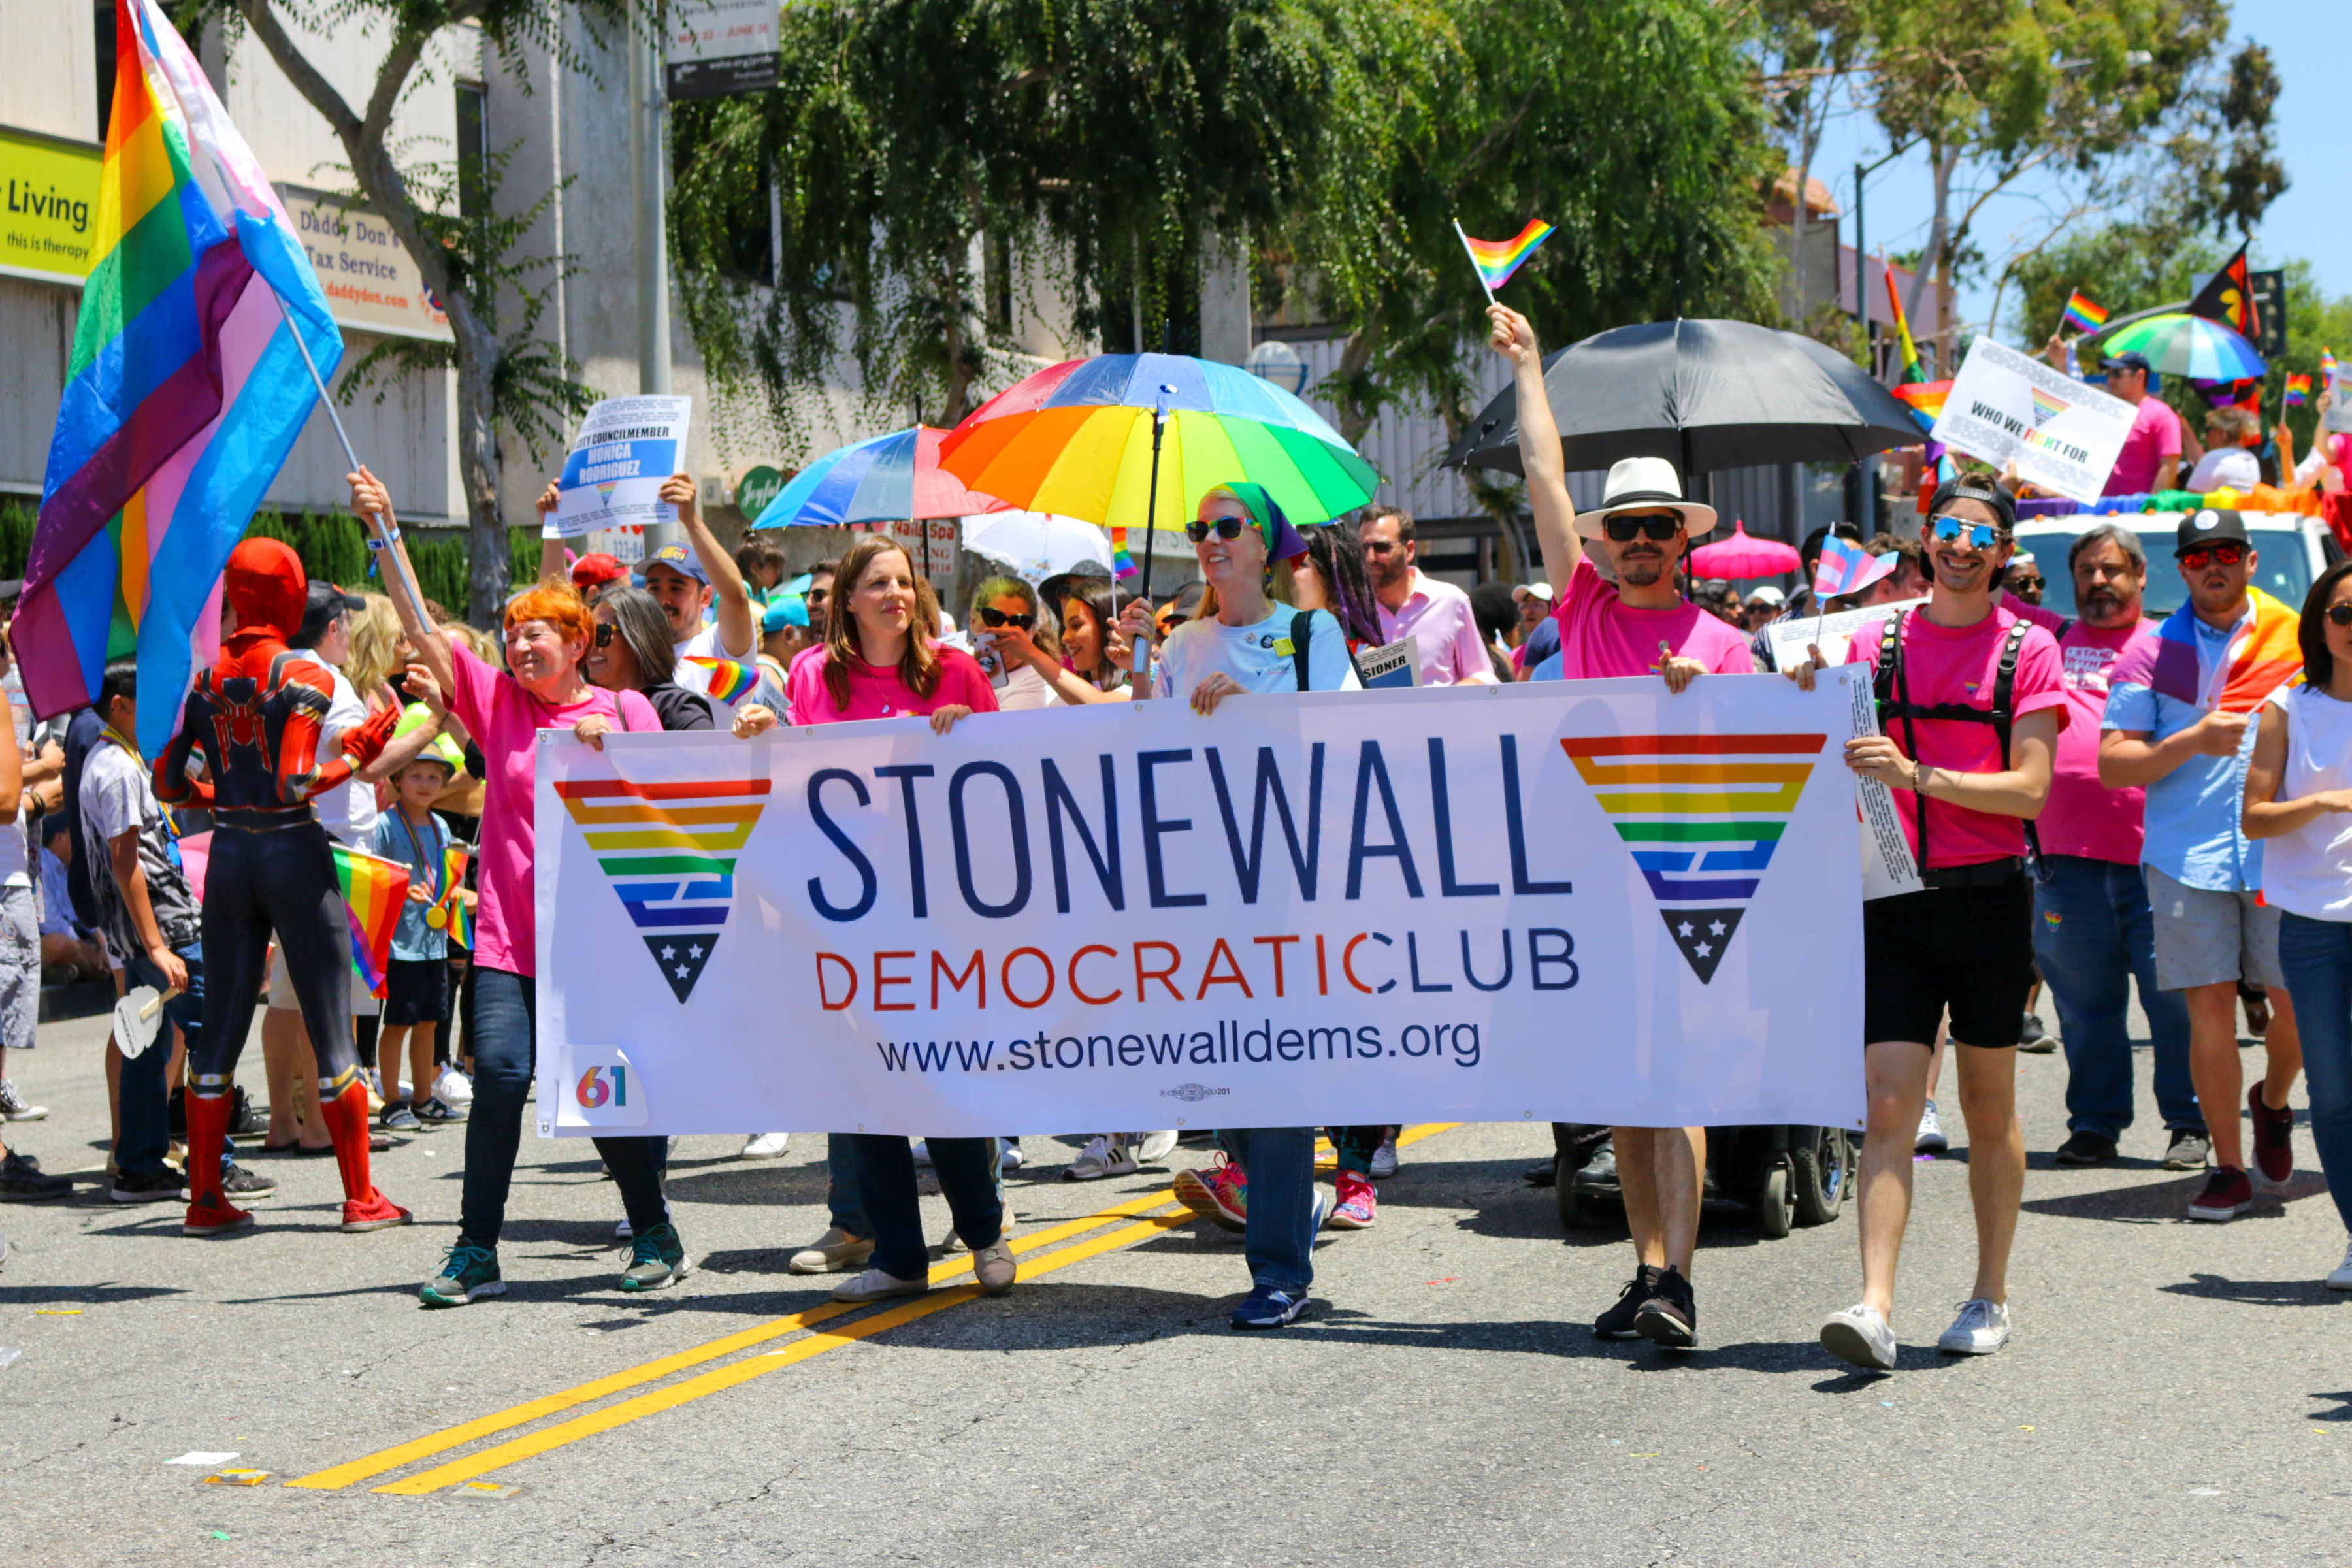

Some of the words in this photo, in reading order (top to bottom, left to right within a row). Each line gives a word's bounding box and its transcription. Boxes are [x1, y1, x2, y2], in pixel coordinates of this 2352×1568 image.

[8, 180, 88, 232] Living
[301, 211, 350, 244] Daddy
[356, 221, 400, 248] Don's
[7, 231, 27, 249] this
[31, 234, 40, 252] is
[43, 236, 89, 261] therapy
[305, 246, 334, 270] Tax
[340, 252, 397, 280] Service
[320, 281, 408, 308] .daddydon.com
[576, 436, 591, 449] CITY
[592, 427, 670, 445] COUNCILMEMBER
[1971, 400, 2002, 425] WHO
[2004, 419, 2024, 436] WE
[2023, 427, 2063, 451] FIGHT
[2063, 444, 2089, 464] FOR
[587, 442, 632, 465] MONICA
[579, 460, 642, 485] RODRIGUEZ
[930, 523, 954, 540] Spa
[1364, 655, 1406, 679] SIONER
[2076, 649, 2114, 659] STAND
[807, 734, 1572, 921] STONEWALL
[877, 1019, 1480, 1071] www.stonewalldems.org
[576, 1066, 626, 1109] 61
